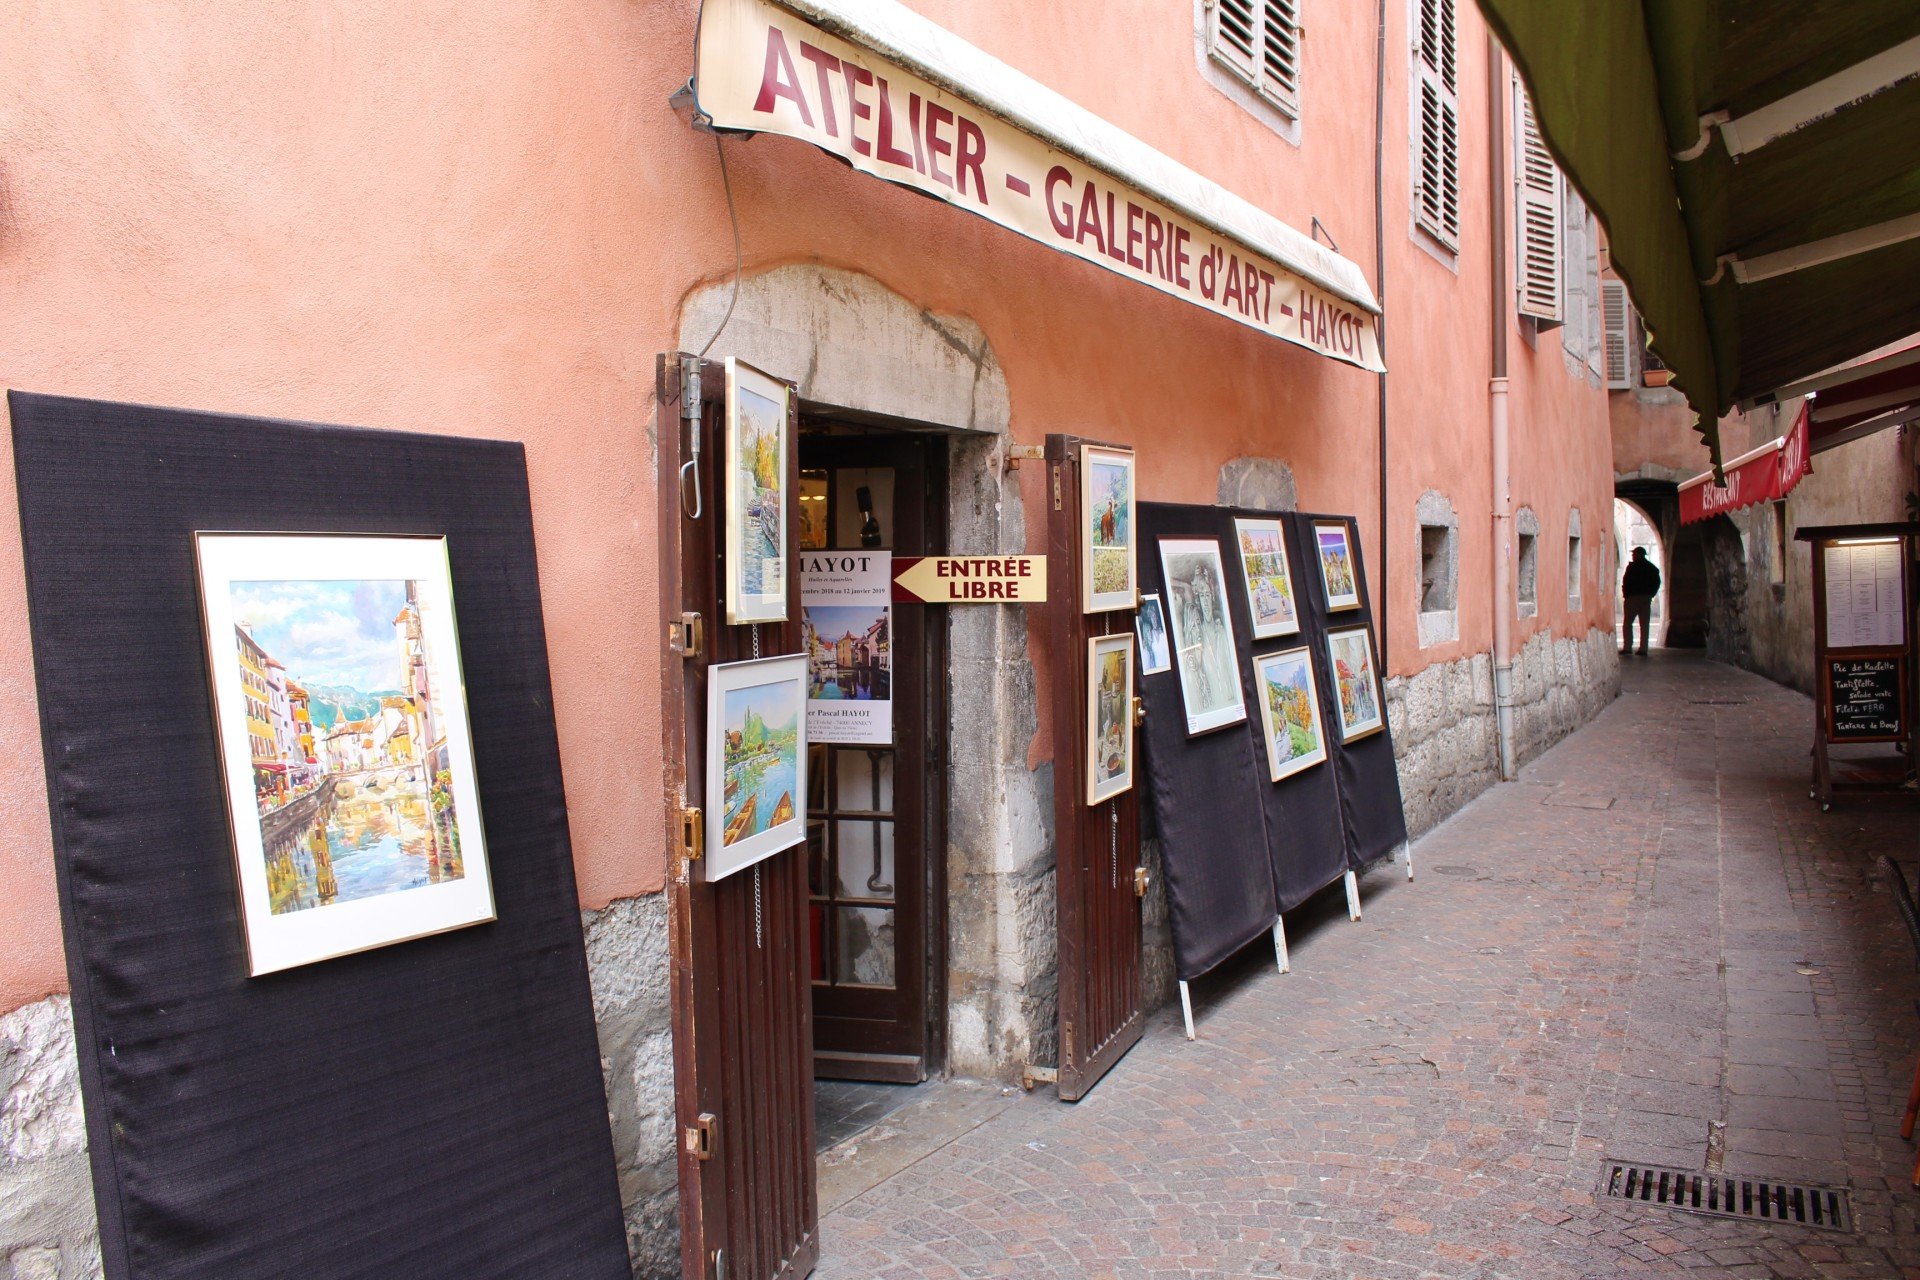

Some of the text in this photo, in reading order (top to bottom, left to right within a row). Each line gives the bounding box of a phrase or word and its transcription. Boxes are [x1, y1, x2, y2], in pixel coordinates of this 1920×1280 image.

[753, 24, 989, 206] ATELIER
[1044, 164, 1191, 291] GALERIE
[1198, 243, 1276, 325] d'ART
[1299, 289, 1365, 362] HAYOT
[936, 556, 1031, 577] ENTRÉE
[851, 588, 871, 596] janvier
[949, 581, 1019, 599] LIBRE
[1851, 663, 1862, 672] de
[817, 709, 840, 717] Pascal
[842, 709, 871, 717] HAYOT
[1835, 721, 1866, 730] Tartare
[1869, 722, 1878, 730] de
